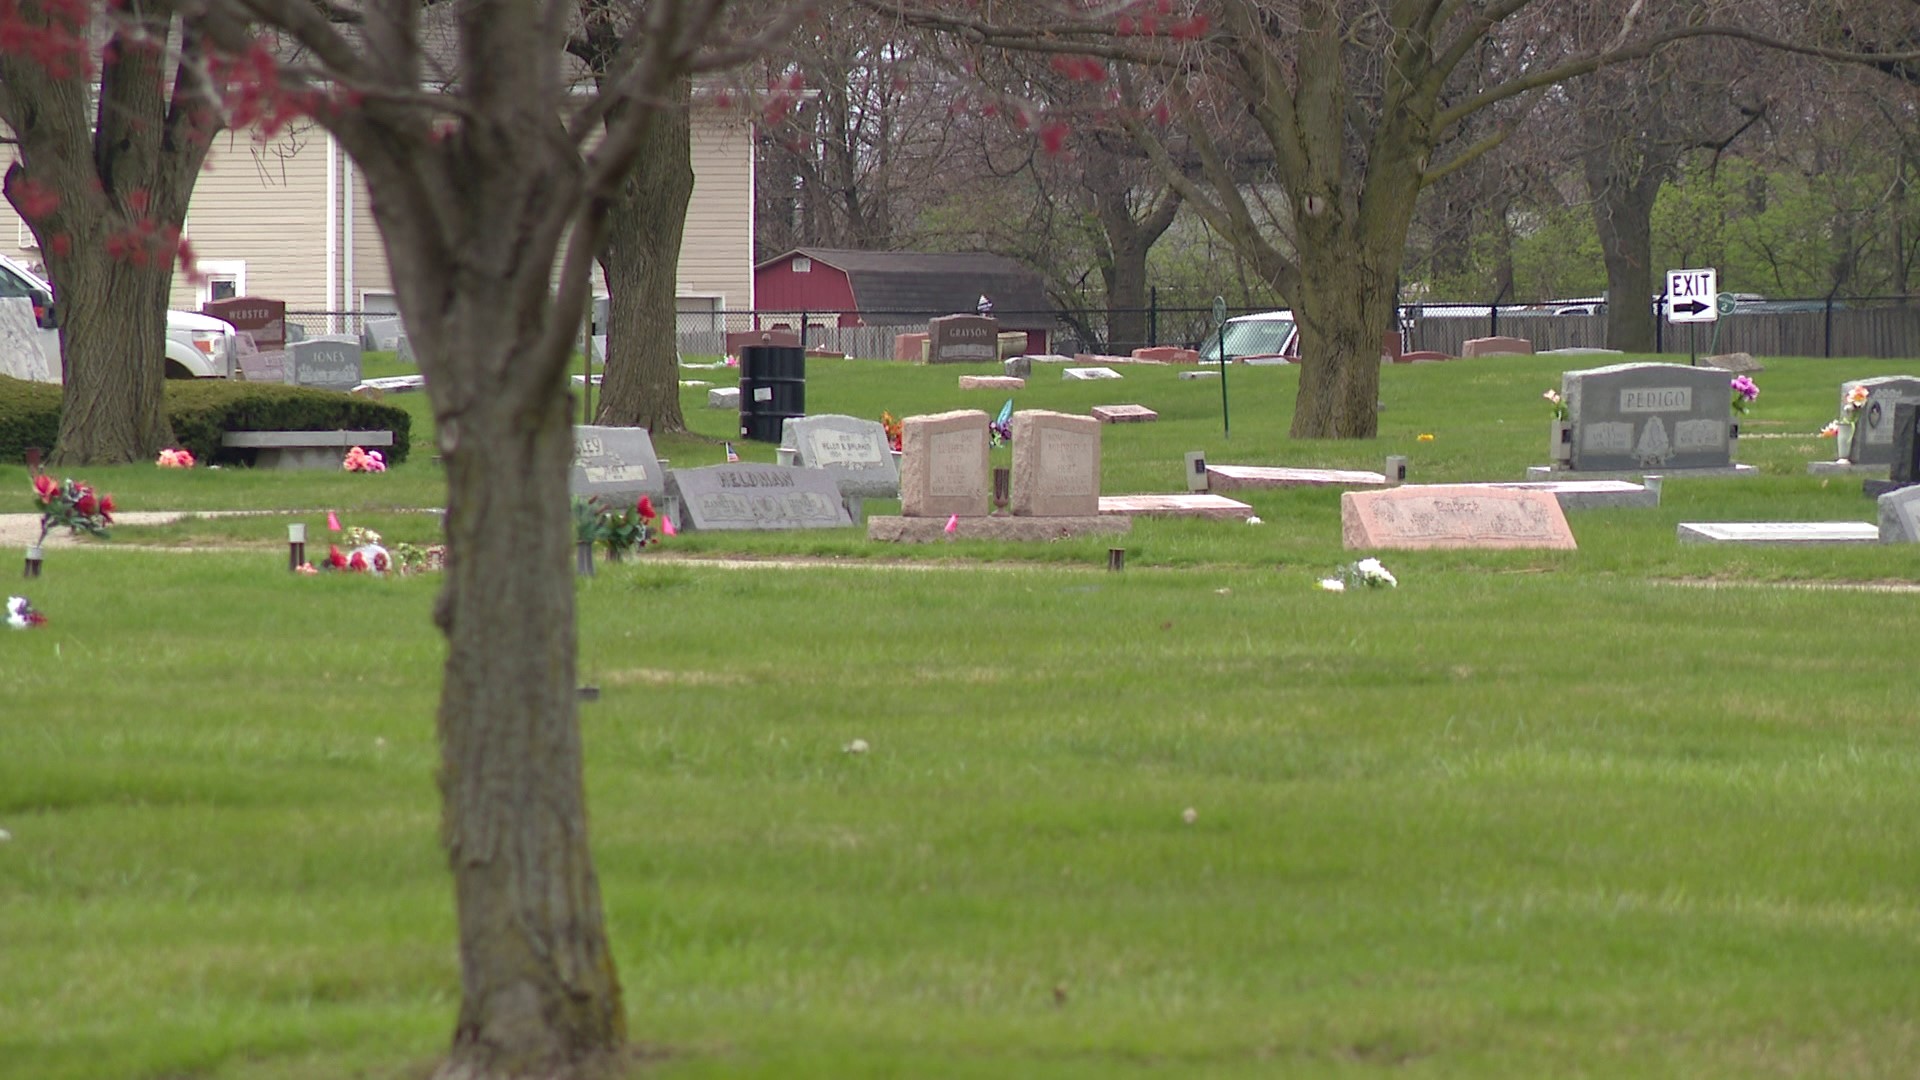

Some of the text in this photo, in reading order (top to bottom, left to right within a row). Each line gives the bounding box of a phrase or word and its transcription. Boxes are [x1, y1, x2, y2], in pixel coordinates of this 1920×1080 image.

[1672, 273, 1711, 297] EXIT
[228, 309, 270, 320] WEBSTER
[949, 327, 989, 338] GRAYSON
[312, 351, 346, 363] JONES
[1626, 390, 1686, 409] PEDIGO
